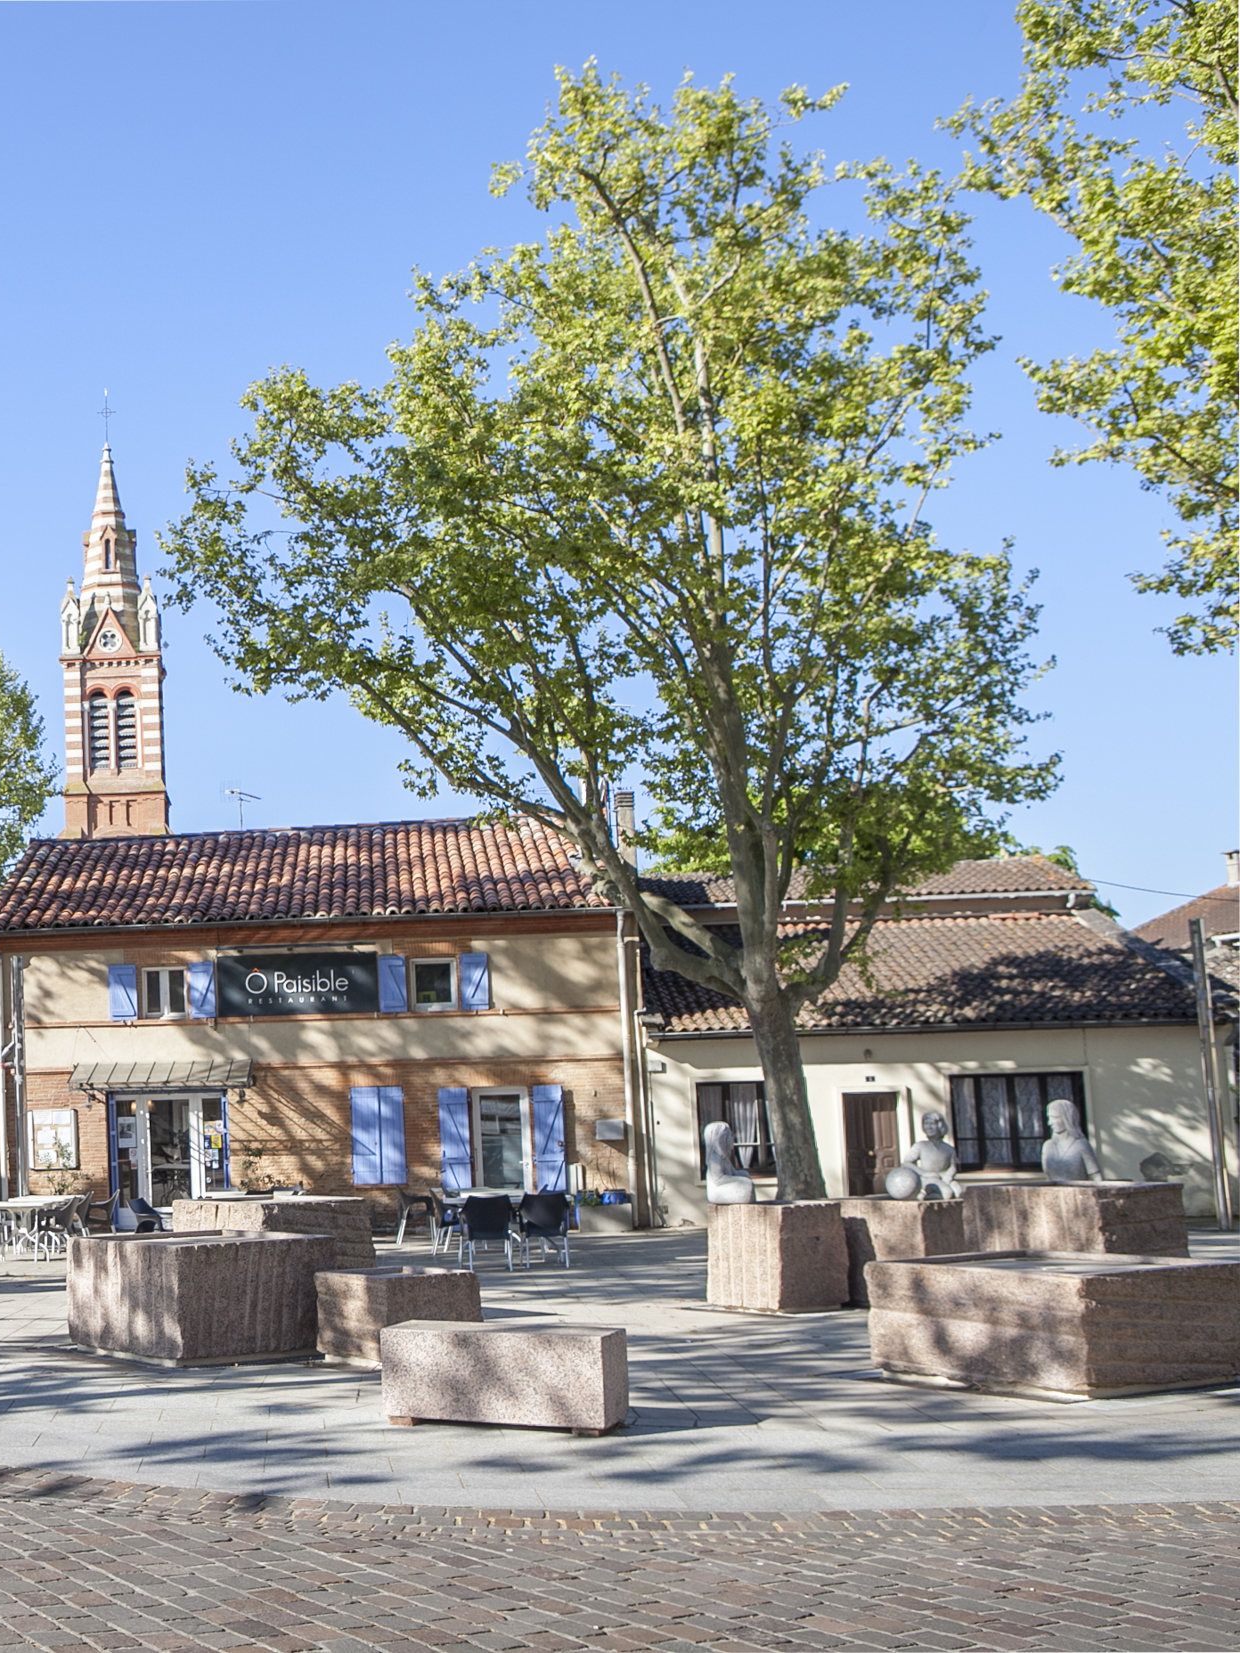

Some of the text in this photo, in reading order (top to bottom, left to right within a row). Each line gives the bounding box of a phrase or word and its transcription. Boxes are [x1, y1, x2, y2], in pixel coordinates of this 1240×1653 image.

[245, 968, 349, 994] Ô Paisible
[248, 996, 348, 1004] RESTAURANT
